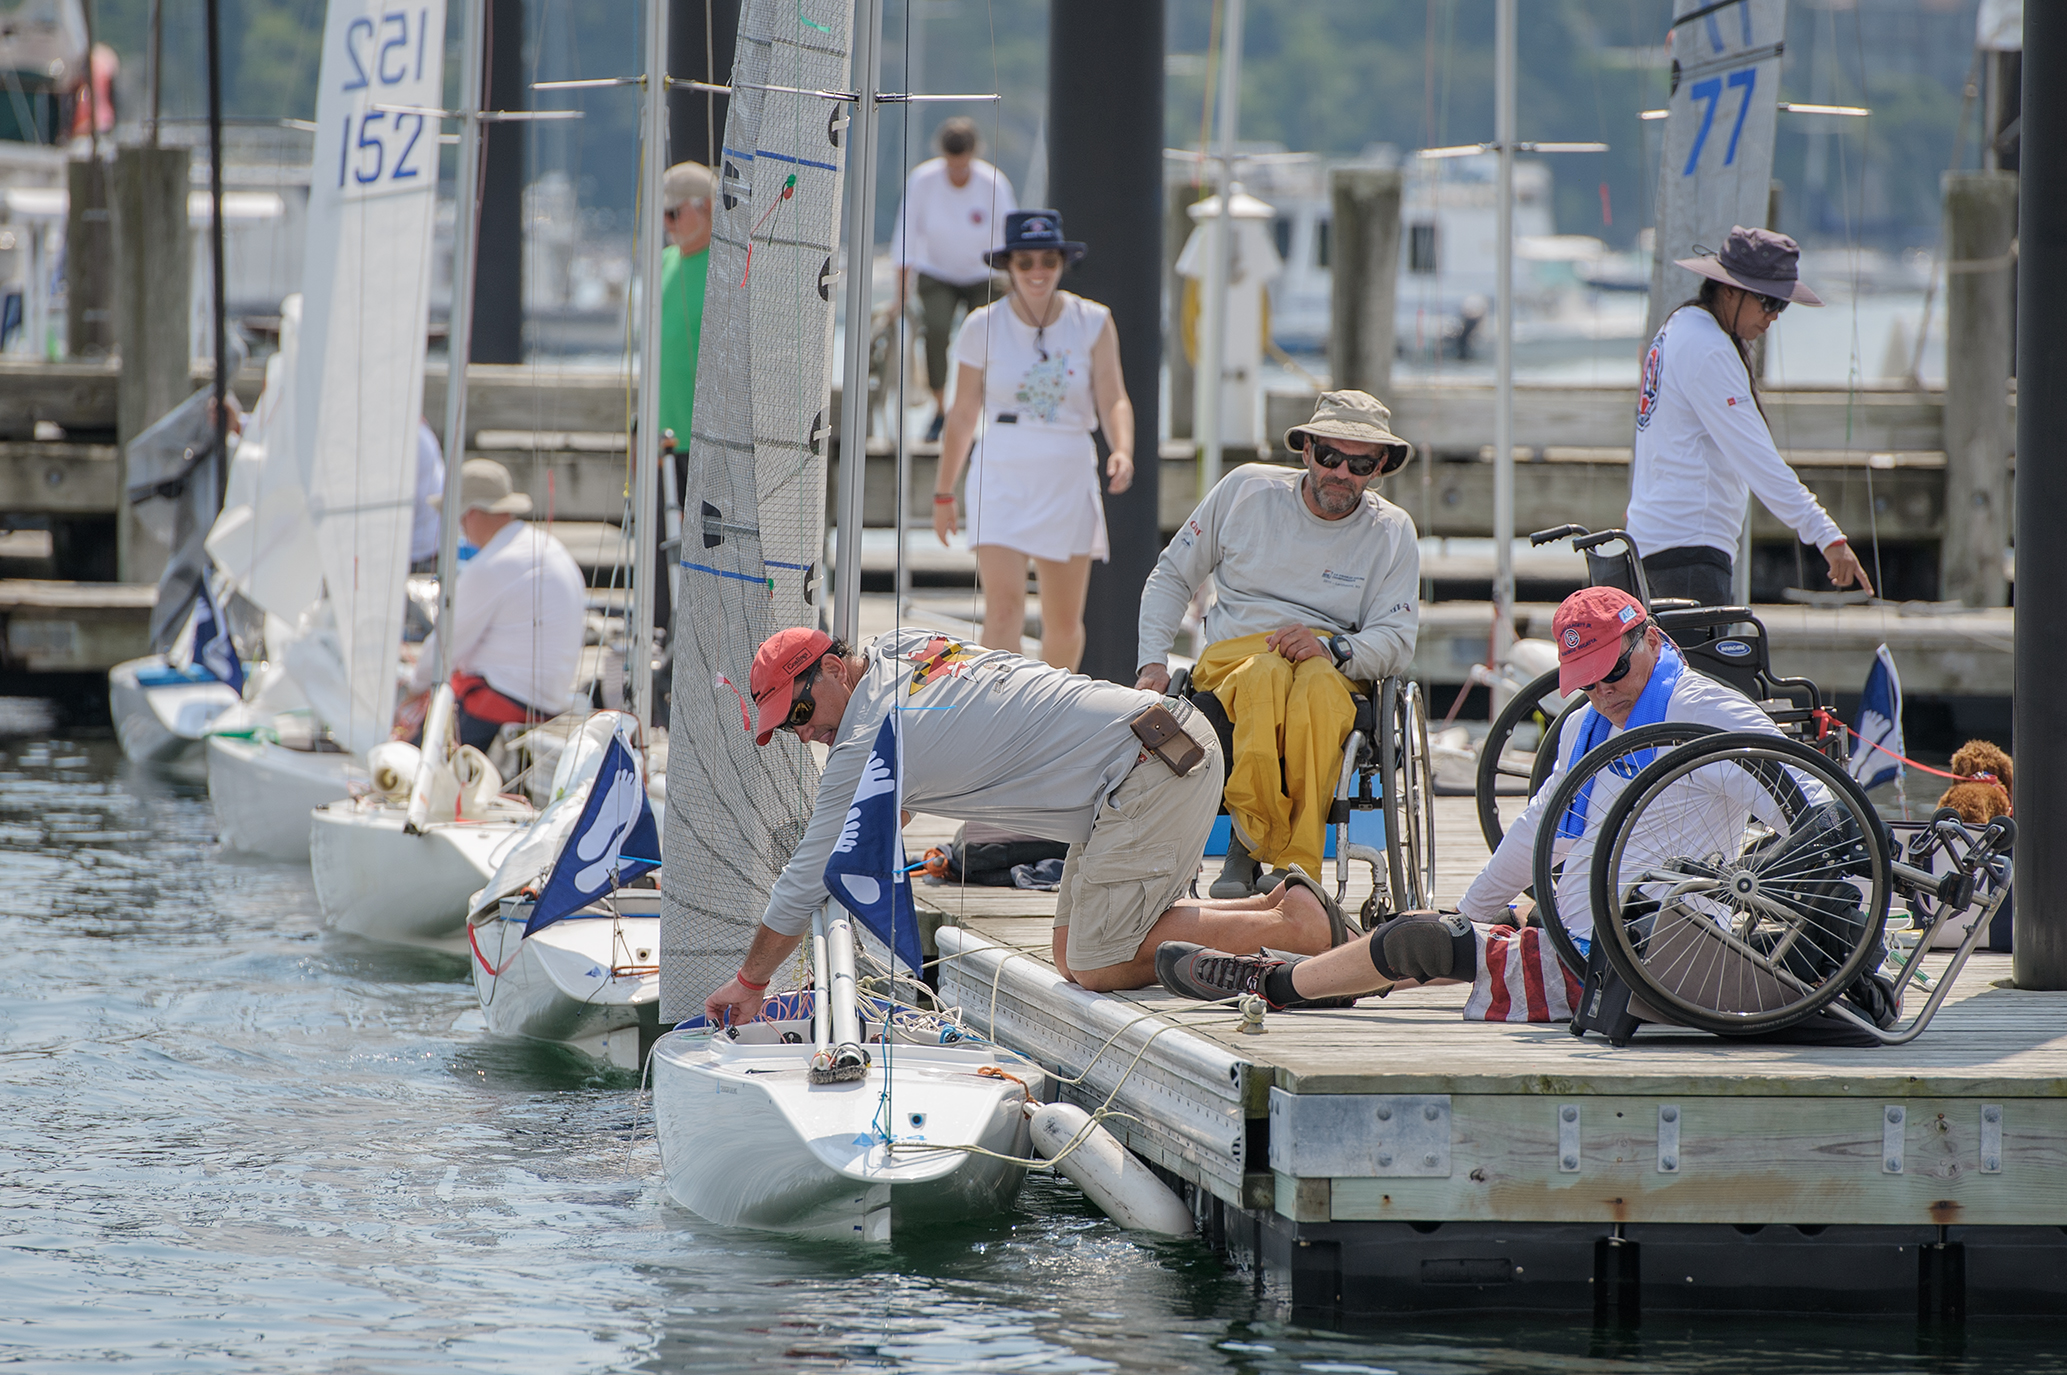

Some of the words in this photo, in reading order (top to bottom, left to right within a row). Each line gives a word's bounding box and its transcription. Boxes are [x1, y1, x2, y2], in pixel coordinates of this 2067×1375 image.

[339, 104, 423, 189] 152
[1683, 67, 1757, 178] 77
[1621, 608, 1635, 620] AIG
